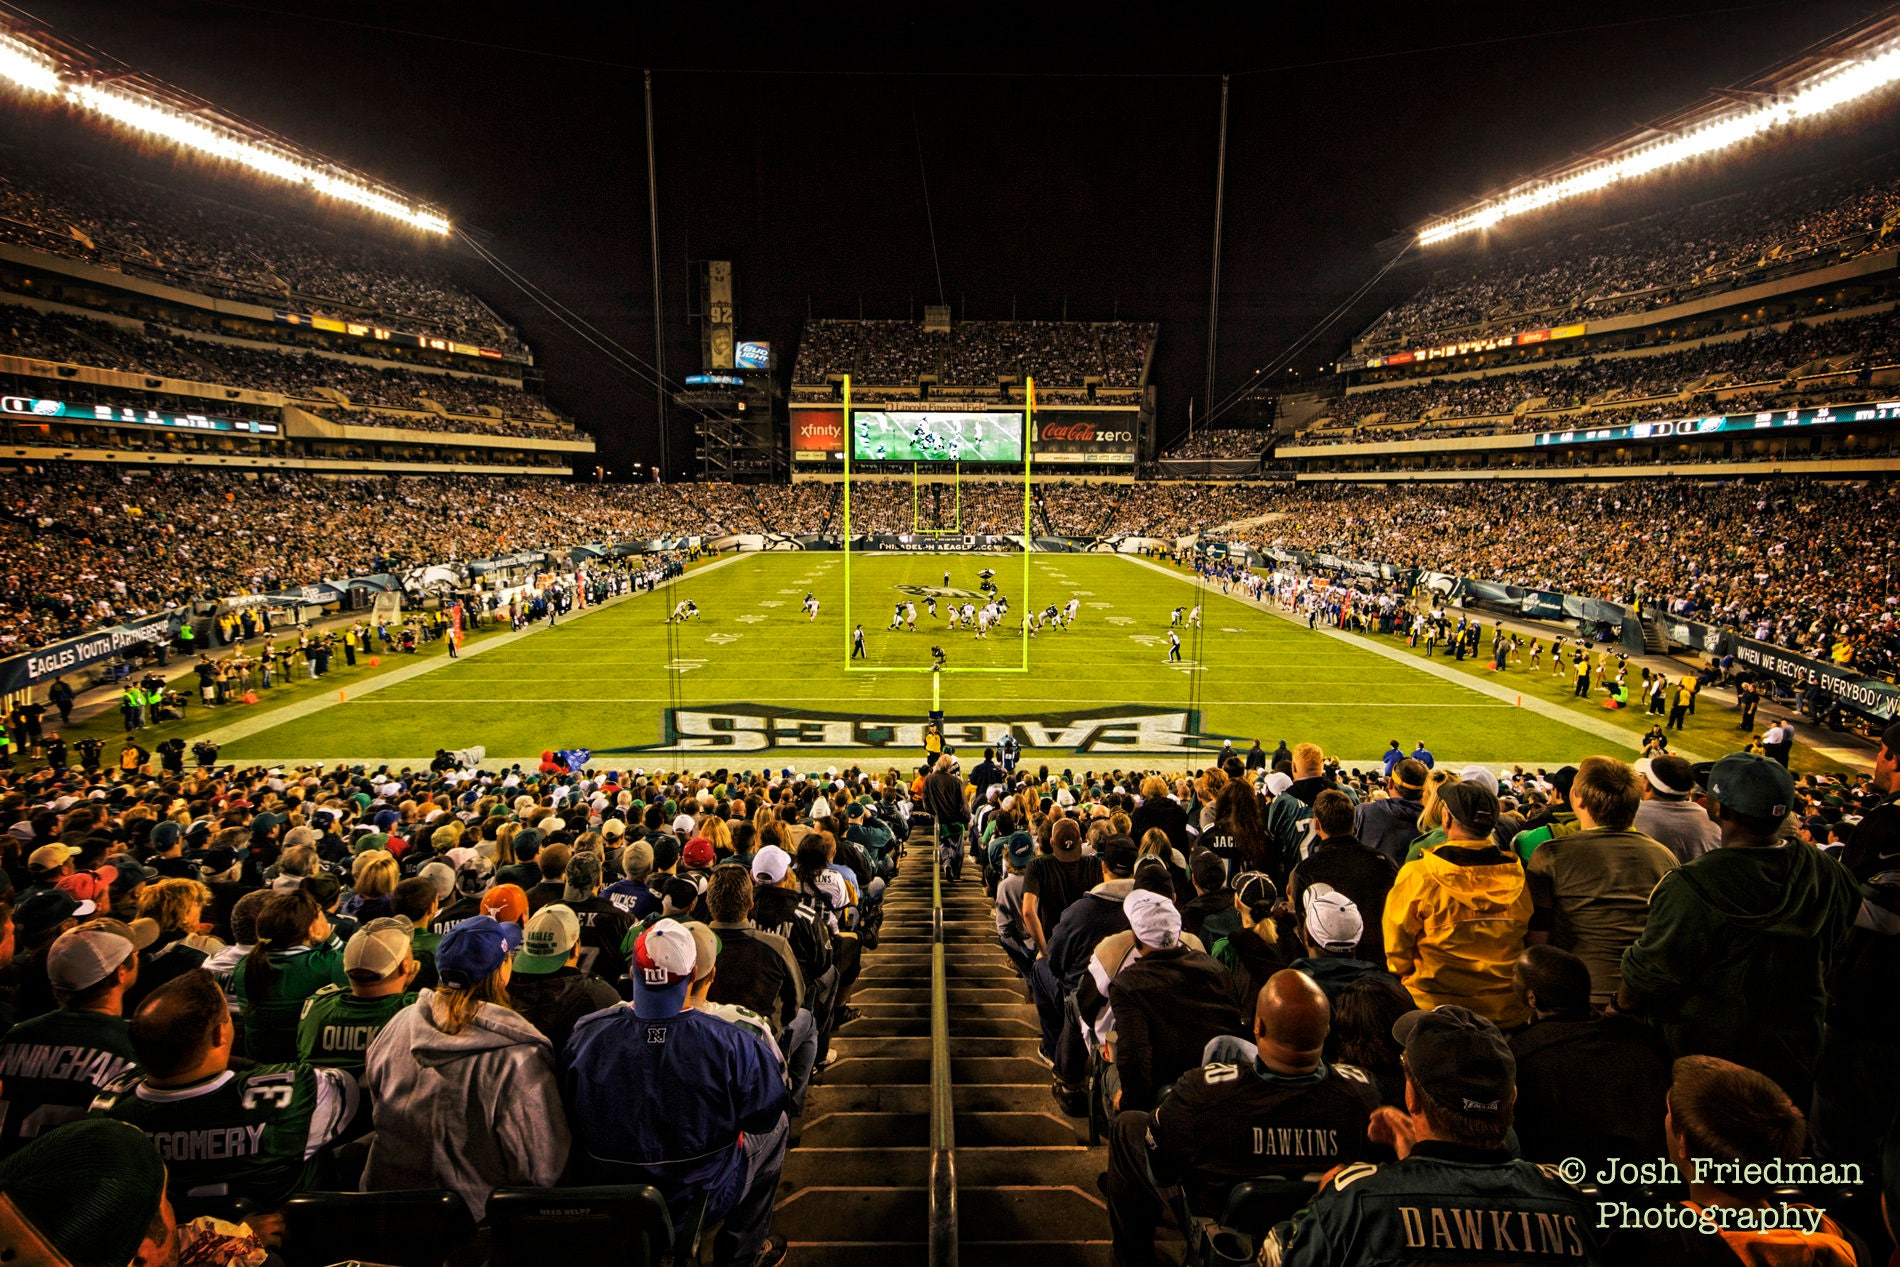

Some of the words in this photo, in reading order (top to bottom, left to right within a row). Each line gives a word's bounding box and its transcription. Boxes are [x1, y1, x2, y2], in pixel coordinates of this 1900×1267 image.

[711, 307, 733, 323] 92
[743, 345, 768, 355] BUD
[896, 402, 927, 411] Lincoln
[929, 402, 965, 411] Financial
[967, 402, 986, 411] Field
[801, 423, 841, 438] xfinity
[1096, 431, 1132, 442] zero
[27, 649, 75, 679] EAGLES
[75, 637, 111, 662] YOUTH
[1737, 645, 1760, 666] WHEN
[1762, 653, 1775, 671] WE
[1777, 658, 1816, 685] RECYCE
[1821, 673, 1882, 711] EVERYBODY
[1213, 835, 1235, 848] JAC
[610, 892, 638, 909] NICKS
[577, 912, 598, 927] EK
[528, 932, 555, 941] EAGLES
[322, 1025, 378, 1051] QUICK
[150, 1122, 267, 1161] GOMERY
[1252, 1126, 1339, 1157] DAWKINS
[1398, 1206, 1585, 1257] DAWKINS
